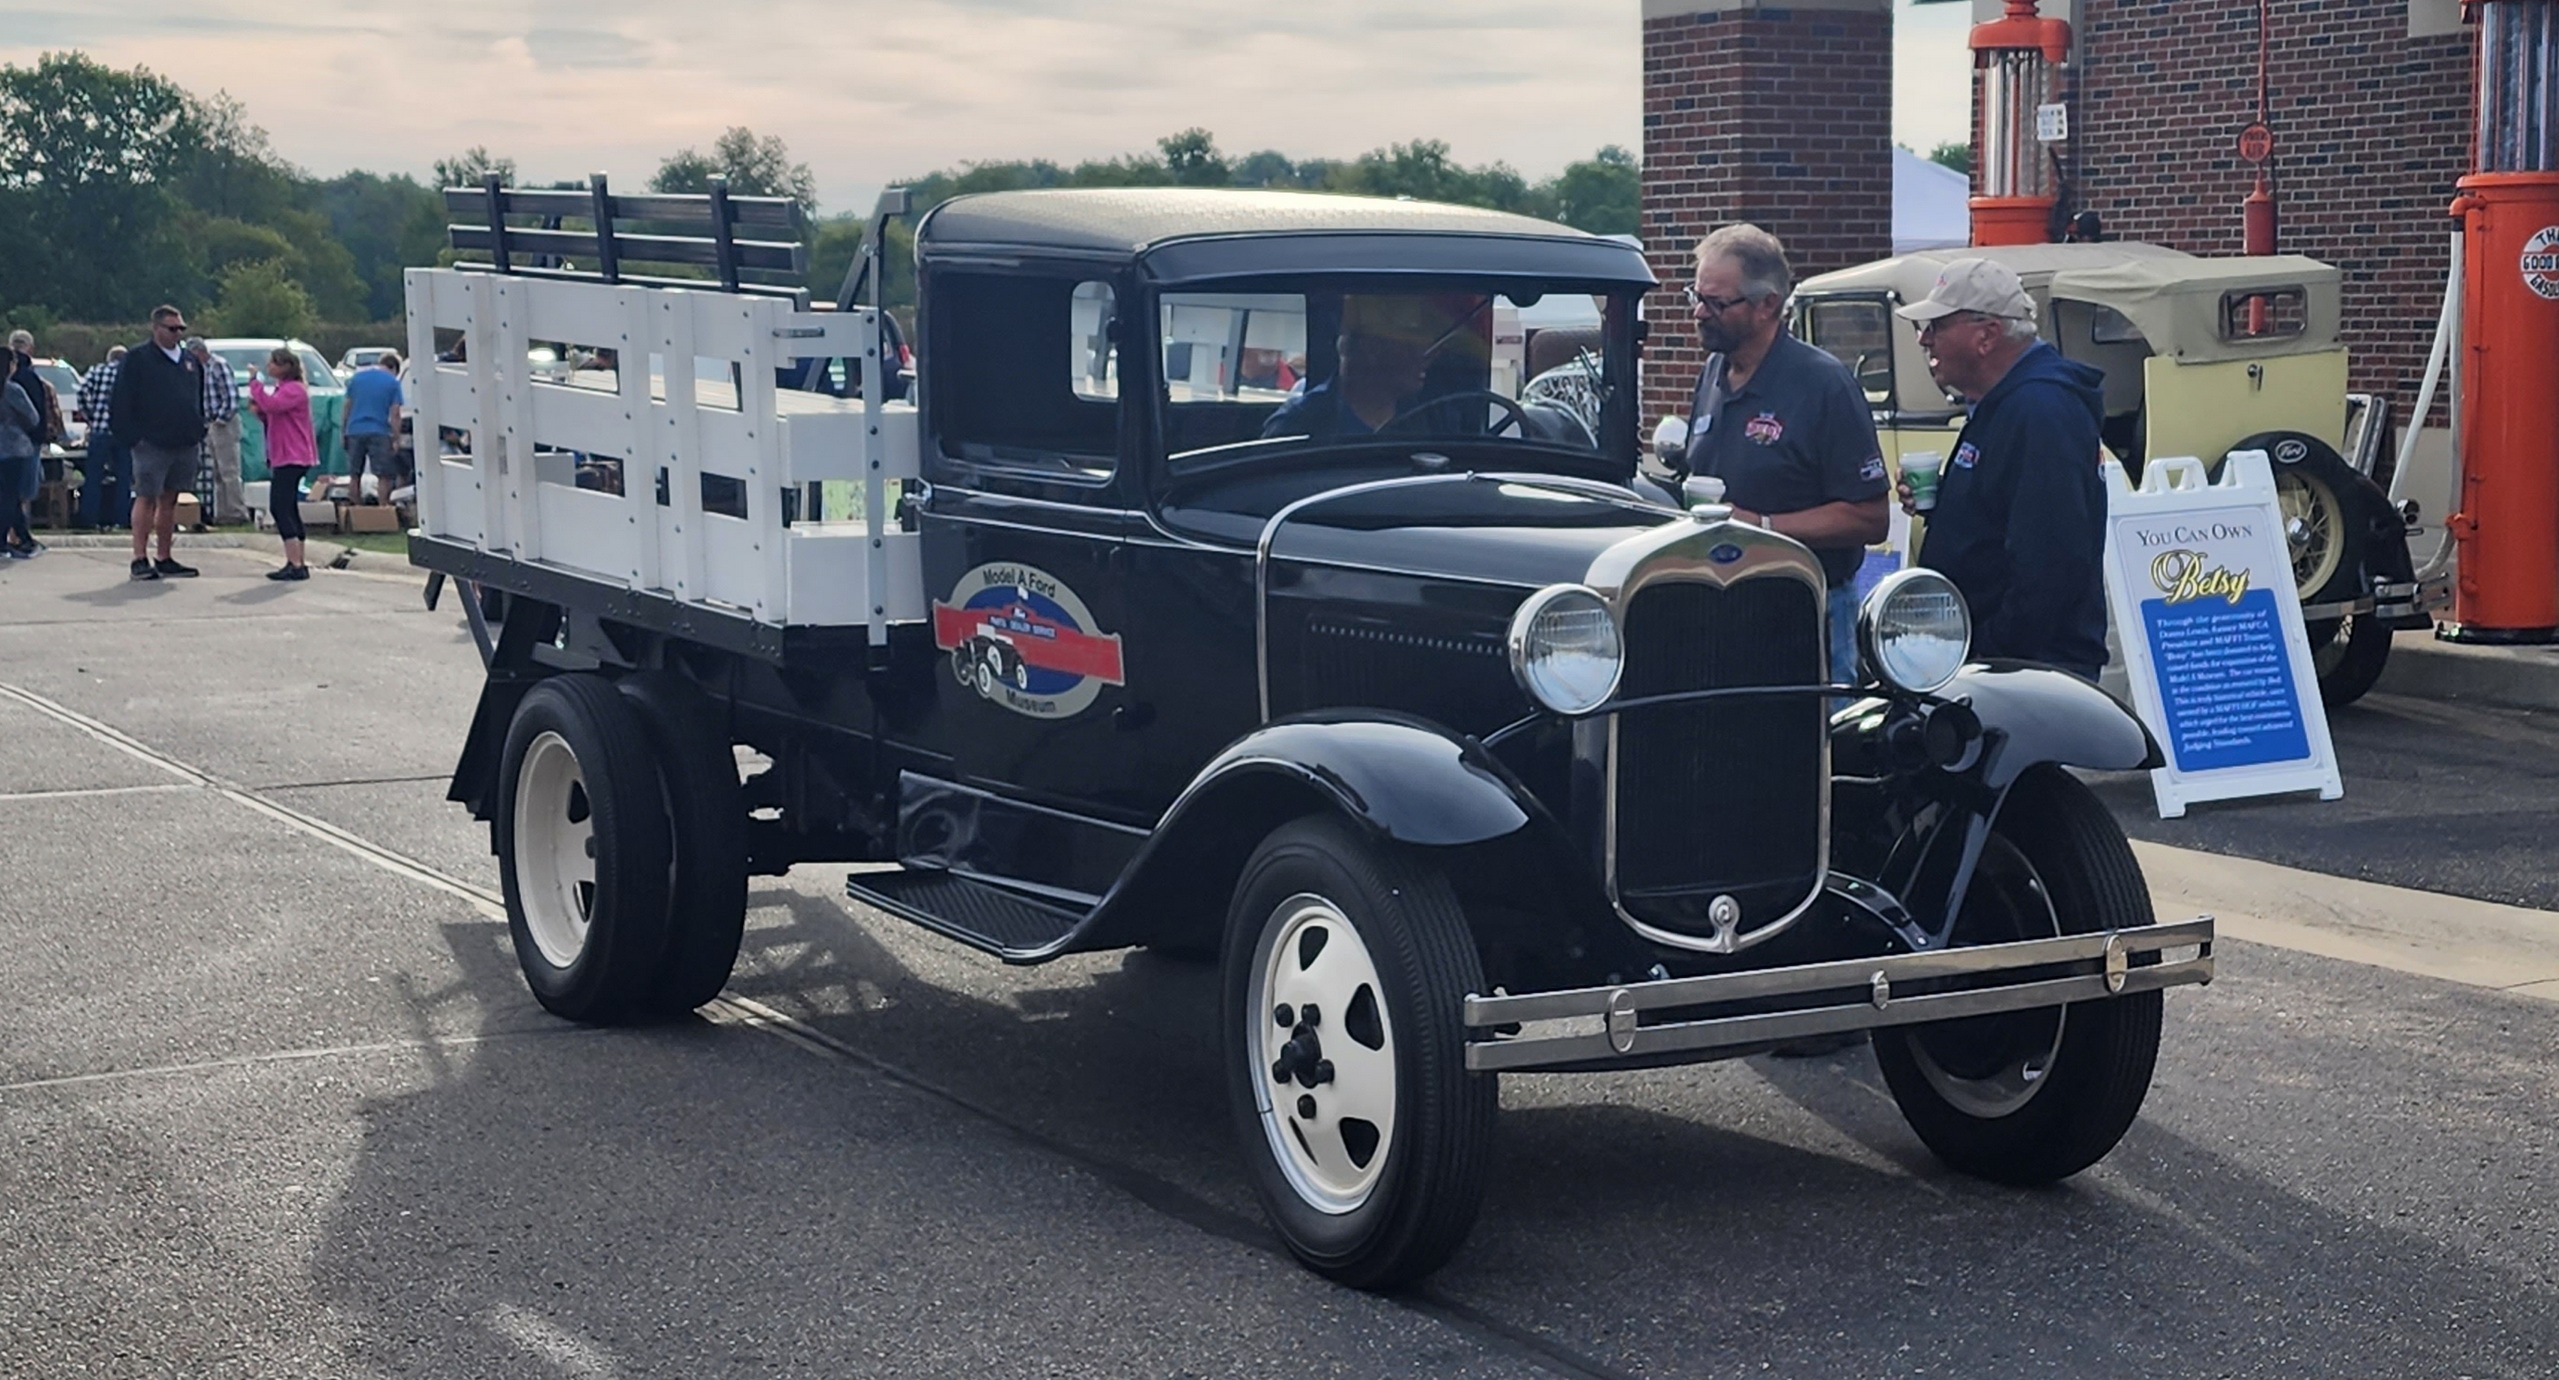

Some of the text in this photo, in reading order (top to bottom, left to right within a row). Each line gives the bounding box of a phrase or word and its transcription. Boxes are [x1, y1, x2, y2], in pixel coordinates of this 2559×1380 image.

[2523, 254, 2553, 270] GOOD
[2136, 523, 2252, 547] YOU CAN OWN
[983, 567, 1056, 598] Model A Ford
[2150, 549, 2250, 605] Betsy
[2157, 616, 2194, 628] Through
[2195, 614, 2210, 624] the
[2257, 608, 2267, 618] of
[1006, 688, 1056, 713] Museum
